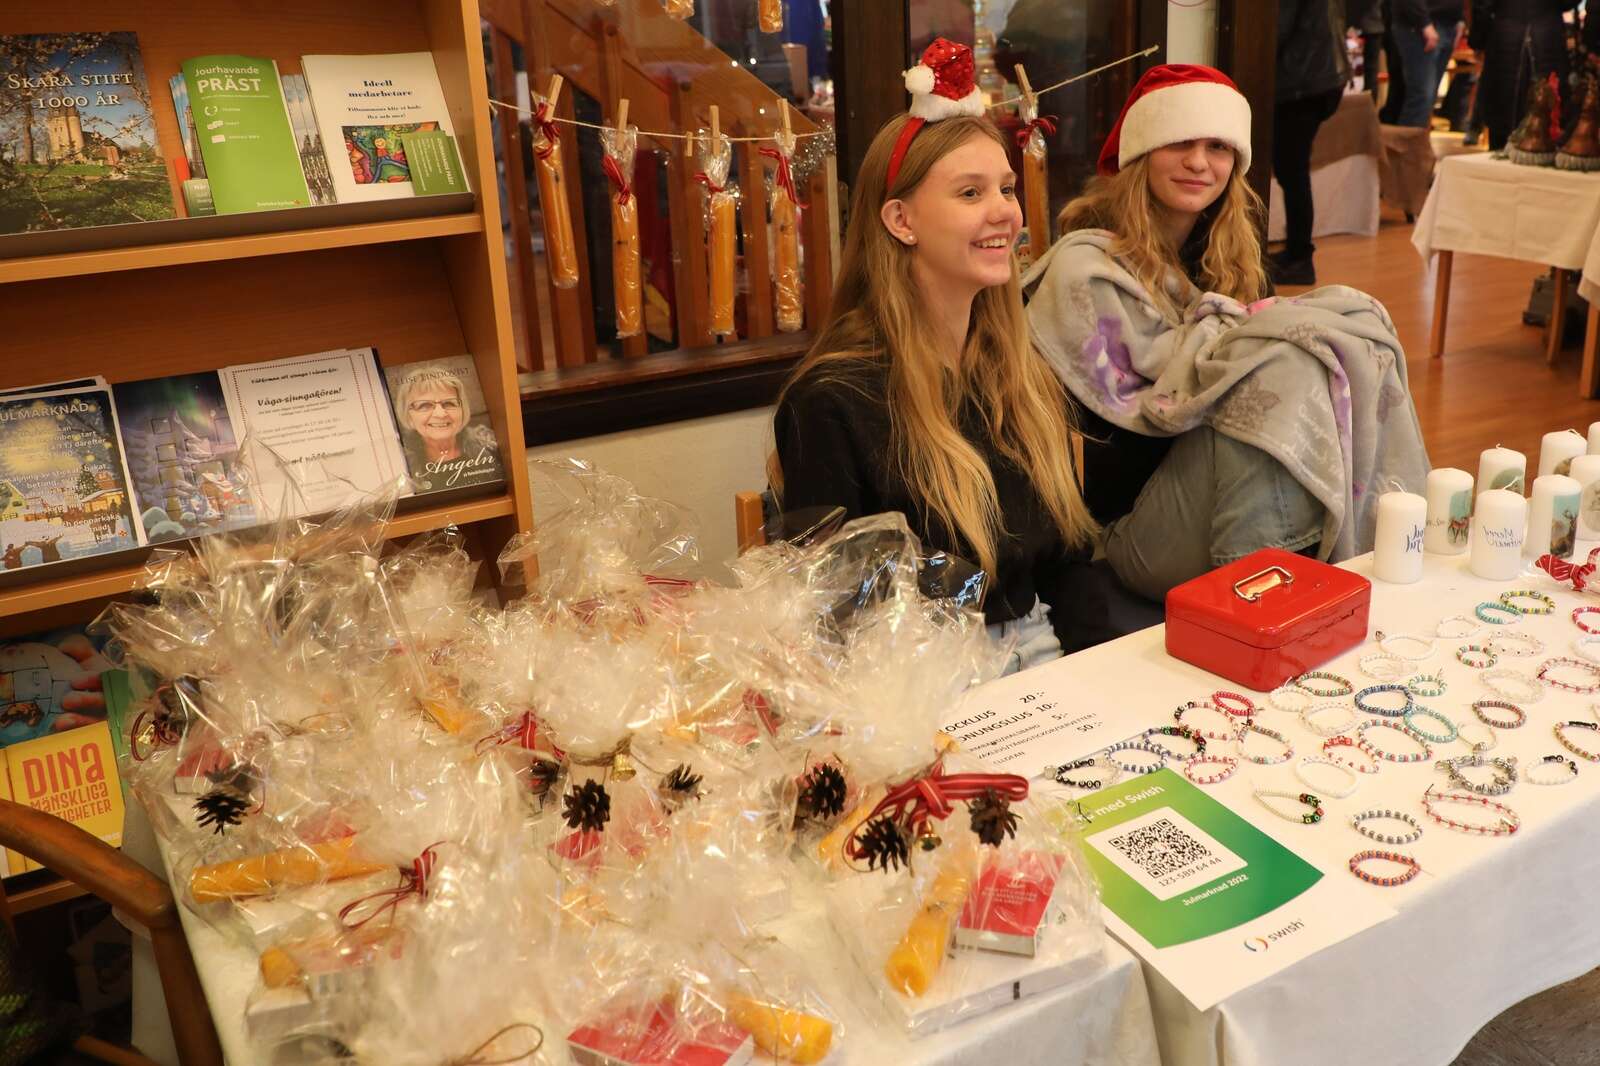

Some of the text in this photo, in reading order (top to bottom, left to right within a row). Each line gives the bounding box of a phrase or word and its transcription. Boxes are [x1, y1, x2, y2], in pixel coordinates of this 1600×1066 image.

[7, 73, 134, 89] SKARA STIFT
[197, 75, 261, 94] PRÄST
[363, 79, 393, 87] Ideell
[38, 91, 122, 109] 1000 ÅR
[348, 90, 413, 98] medarbetare
[0, 402, 89, 421] ULMARKNAD
[415, 447, 495, 486] Ängeln
[940, 709, 997, 734] LOCKLJUS
[959, 711, 1033, 743] ONUNGSLJUS
[1095, 786, 1165, 816] med Swish
[1183, 874, 1248, 906] Julmarknad 2022
[1267, 919, 1304, 943] swish
